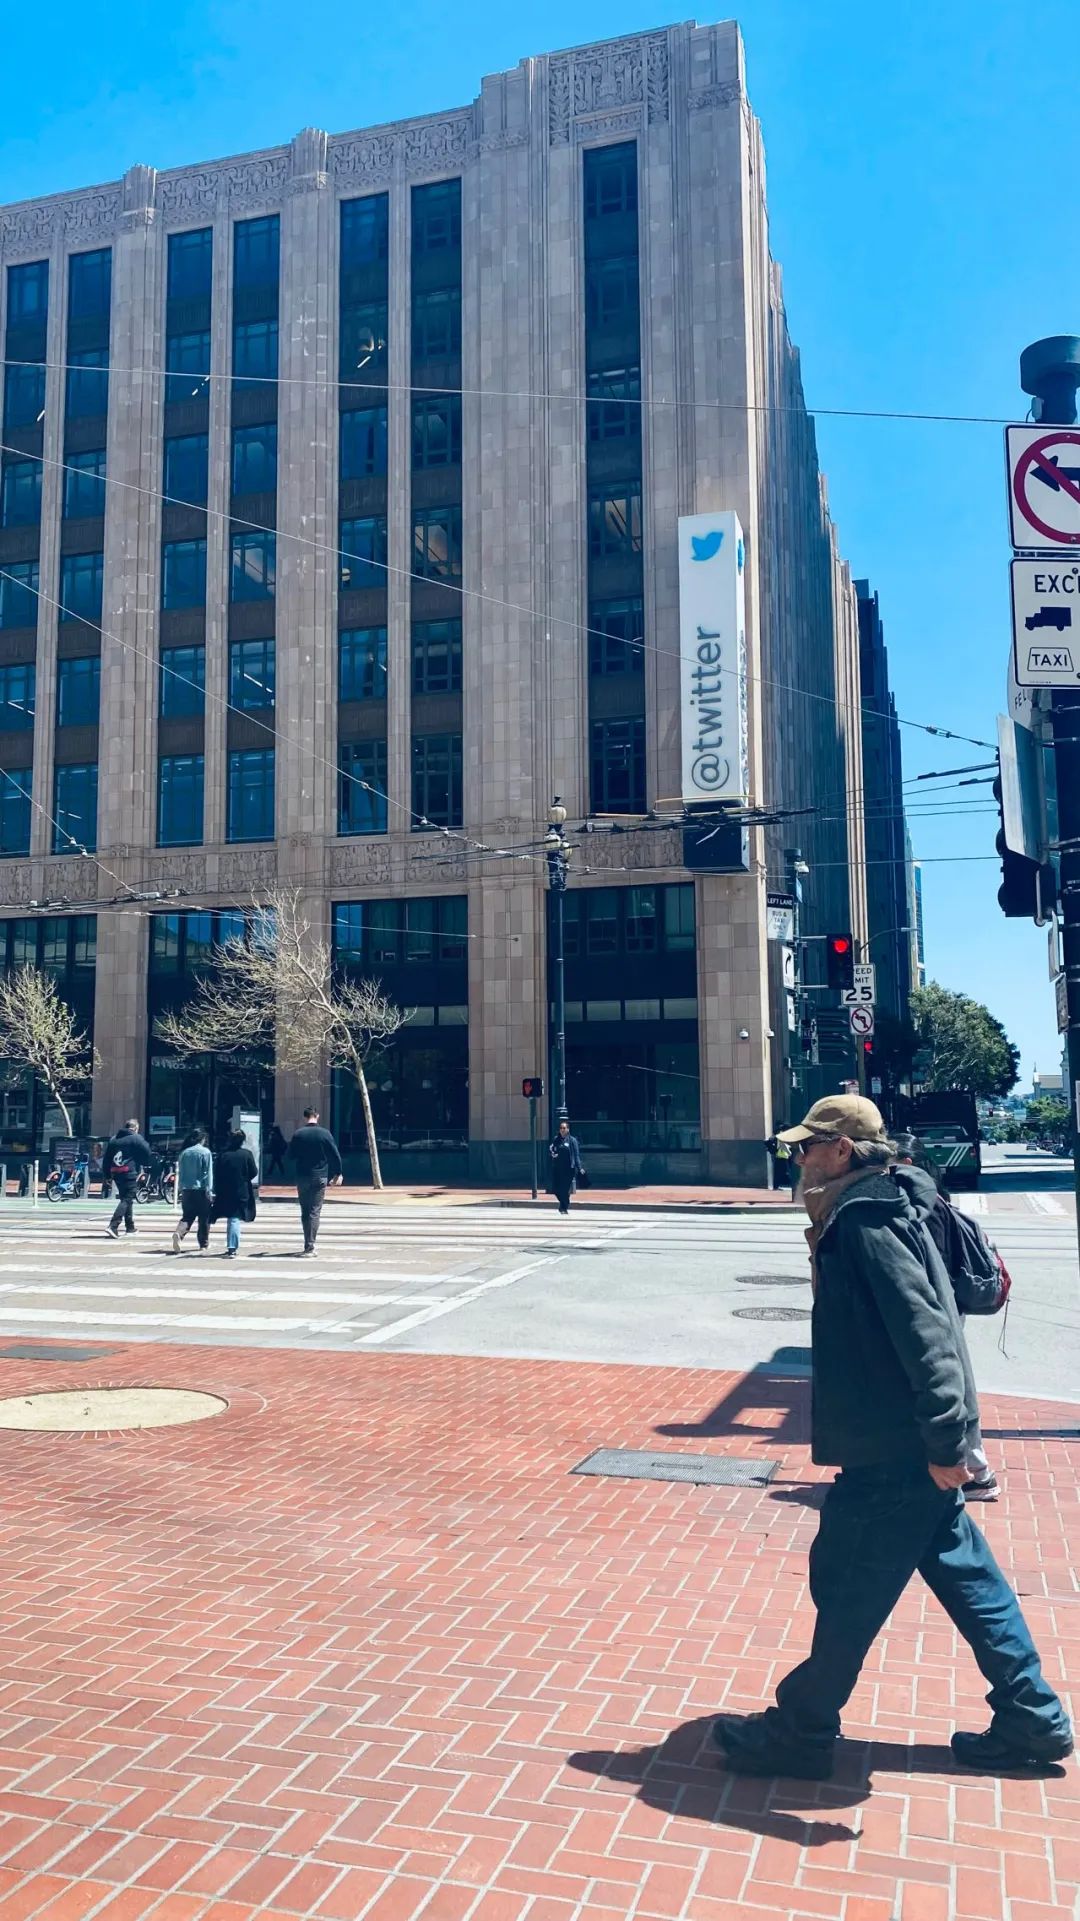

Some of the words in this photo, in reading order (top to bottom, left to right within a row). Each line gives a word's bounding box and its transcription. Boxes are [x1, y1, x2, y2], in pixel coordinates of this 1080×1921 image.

[1034, 574, 1080, 594] EXC
[1031, 654, 1068, 666] TAXI
[1014, 689, 1027, 710] FEL
[691, 625, 730, 792] @twitter
[779, 898, 793, 906] LANE
[855, 967, 872, 975] EED
[854, 976, 870, 984] MIT
[845, 986, 872, 1001] 25
